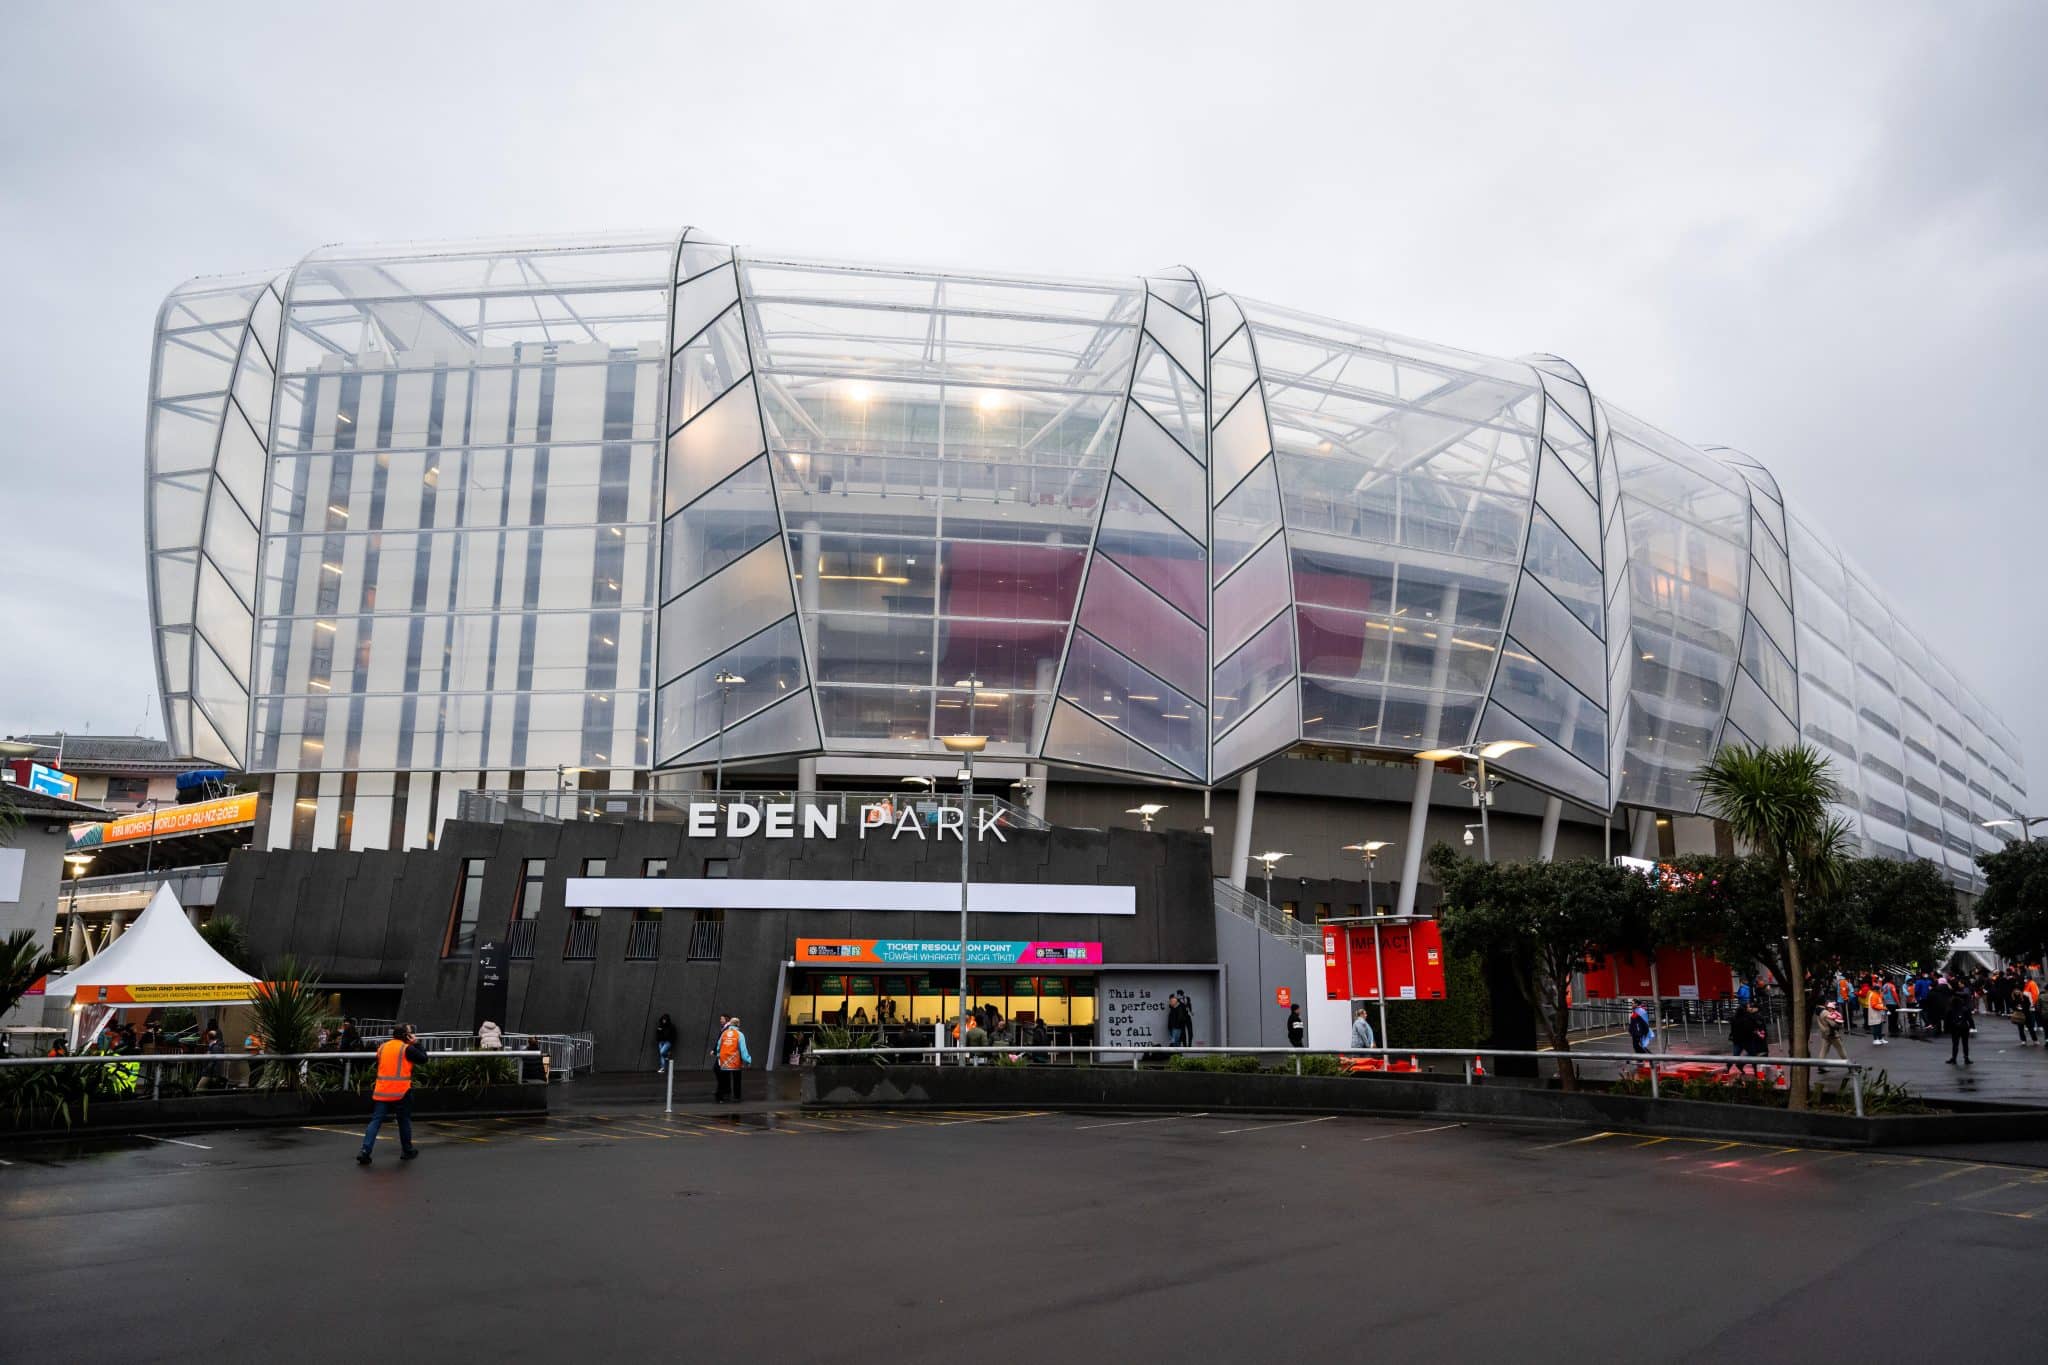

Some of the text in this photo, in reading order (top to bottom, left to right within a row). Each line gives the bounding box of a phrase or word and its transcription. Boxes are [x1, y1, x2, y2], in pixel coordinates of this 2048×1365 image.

[154, 815, 176, 830] WORLD
[178, 813, 192, 827] CUP
[688, 803, 1007, 842] EDEN PARK
[887, 943, 919, 951] TICKET
[983, 944, 1012, 952] POINT
[1351, 935, 1410, 950] IMPACT
[1109, 989, 1151, 998] This is
[1109, 1001, 1165, 1013] a perfect
[1108, 1015, 1133, 1025] spot
[1110, 1026, 1152, 1036] to fall
